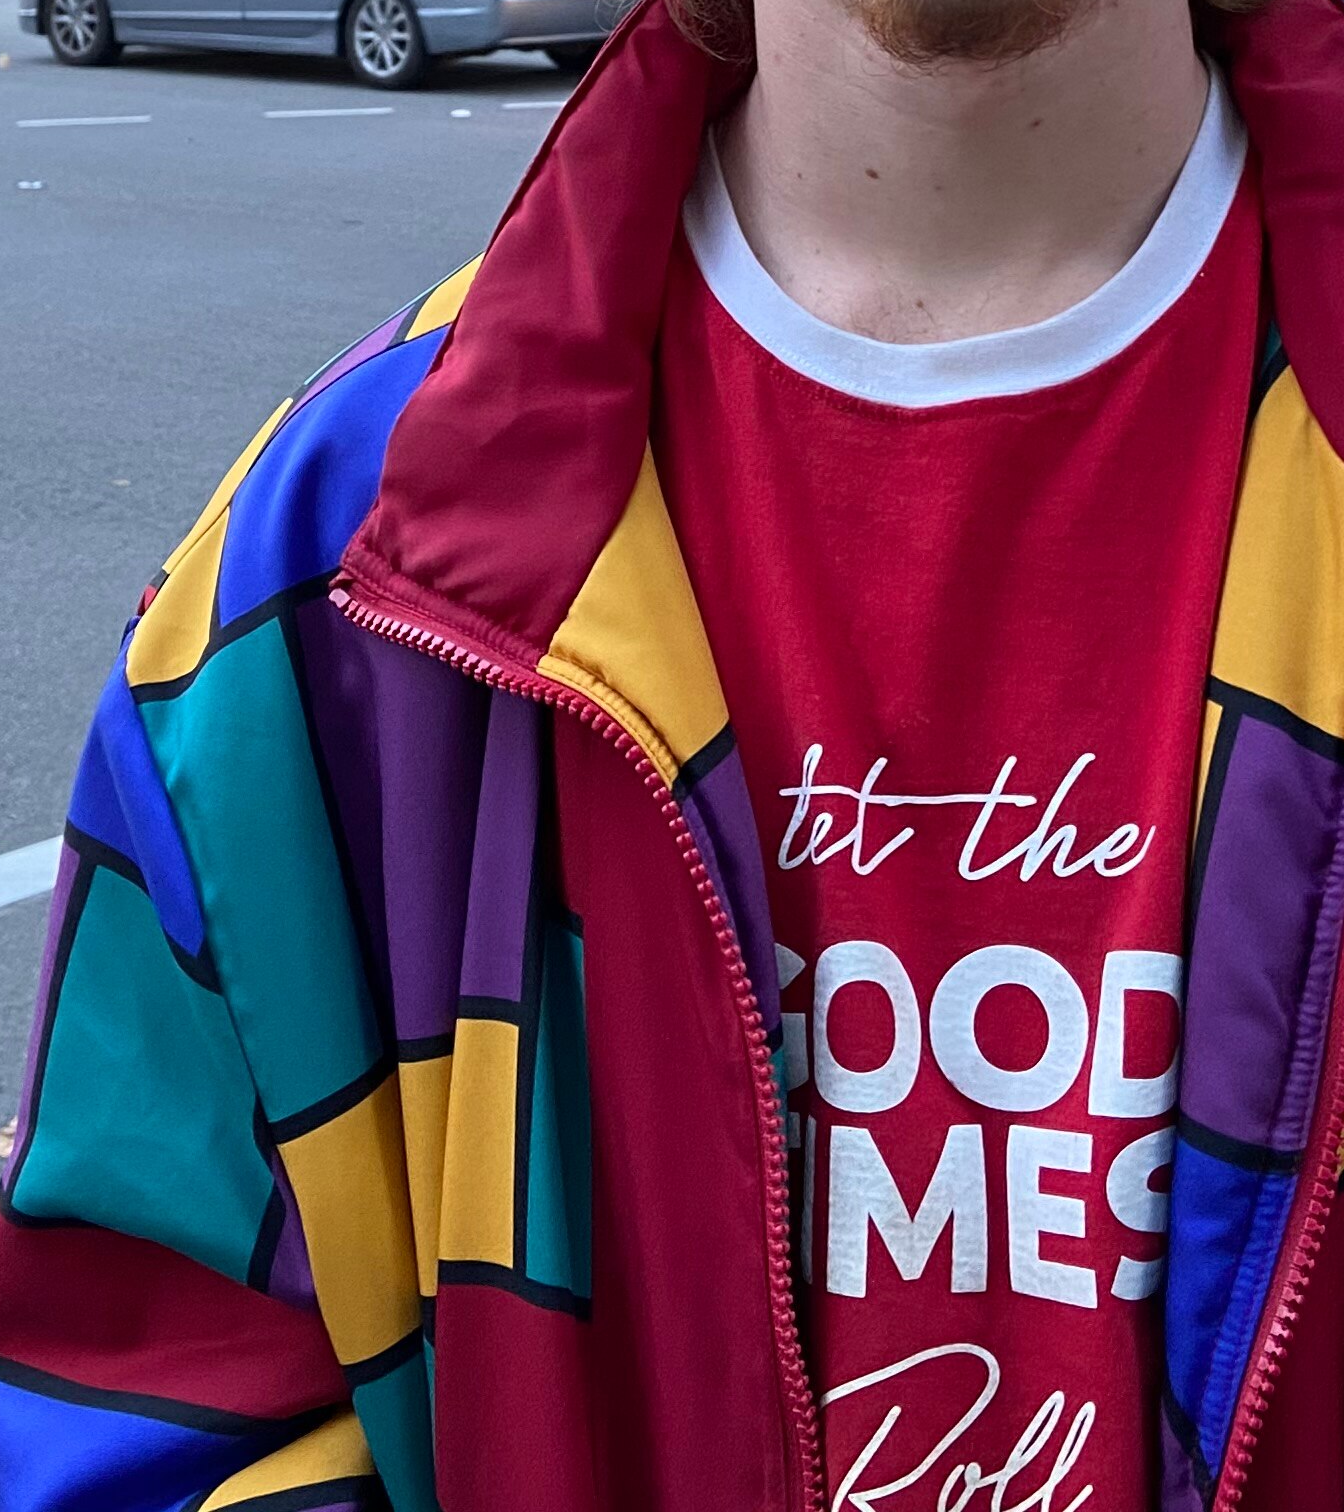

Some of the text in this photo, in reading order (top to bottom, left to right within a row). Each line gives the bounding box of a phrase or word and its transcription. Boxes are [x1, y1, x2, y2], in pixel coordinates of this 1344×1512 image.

[959, 752, 1156, 882] the
[787, 1111, 1177, 1309] IMES
[819, 1343, 1097, 1512] Roll
